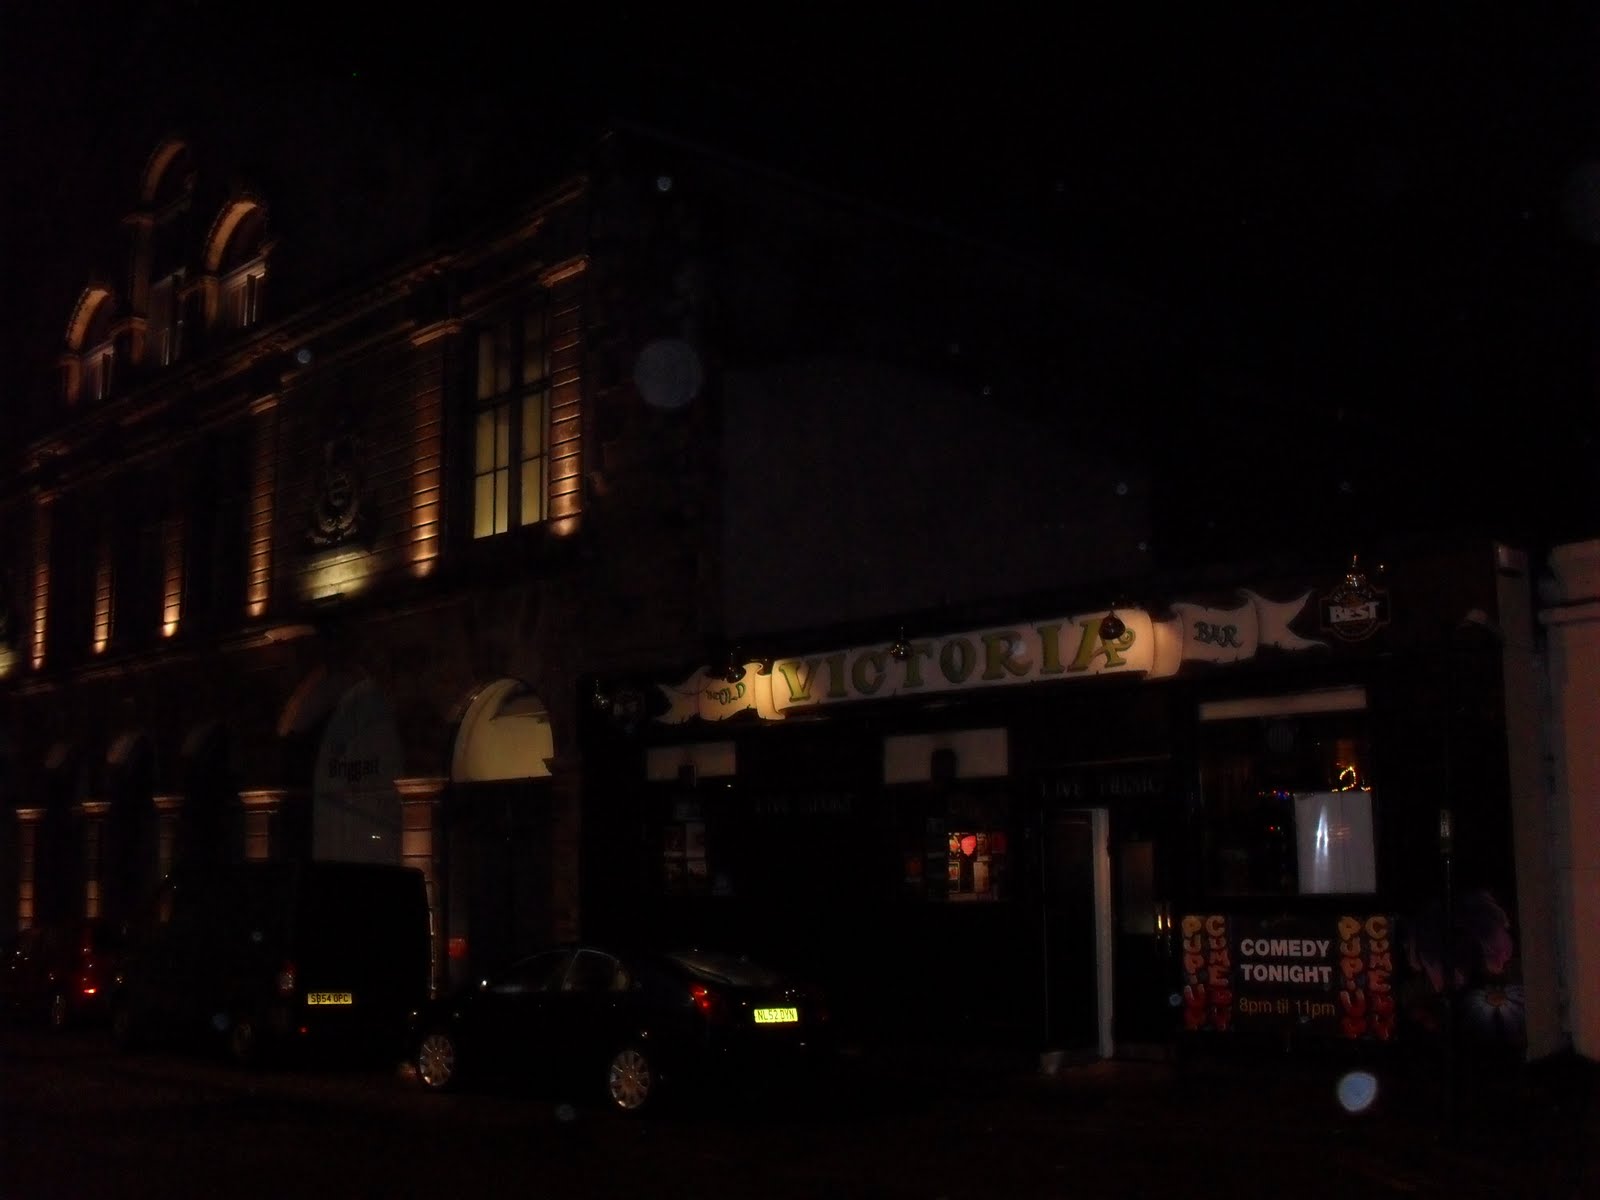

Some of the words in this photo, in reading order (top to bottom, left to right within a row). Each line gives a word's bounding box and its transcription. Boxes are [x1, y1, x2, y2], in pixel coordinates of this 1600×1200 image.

[1328, 600, 1379, 624] BEST
[719, 682, 746, 705] OLD
[778, 617, 1136, 703] VICTORIA
[1193, 621, 1242, 648] BAR
[1240, 938, 1330, 957] COMEDY
[1240, 963, 1333, 984] TONIGHT
[1239, 997, 1272, 1014] 8pm
[1277, 998, 1289, 1014] til
[1296, 1001, 1336, 1018] 11pm
